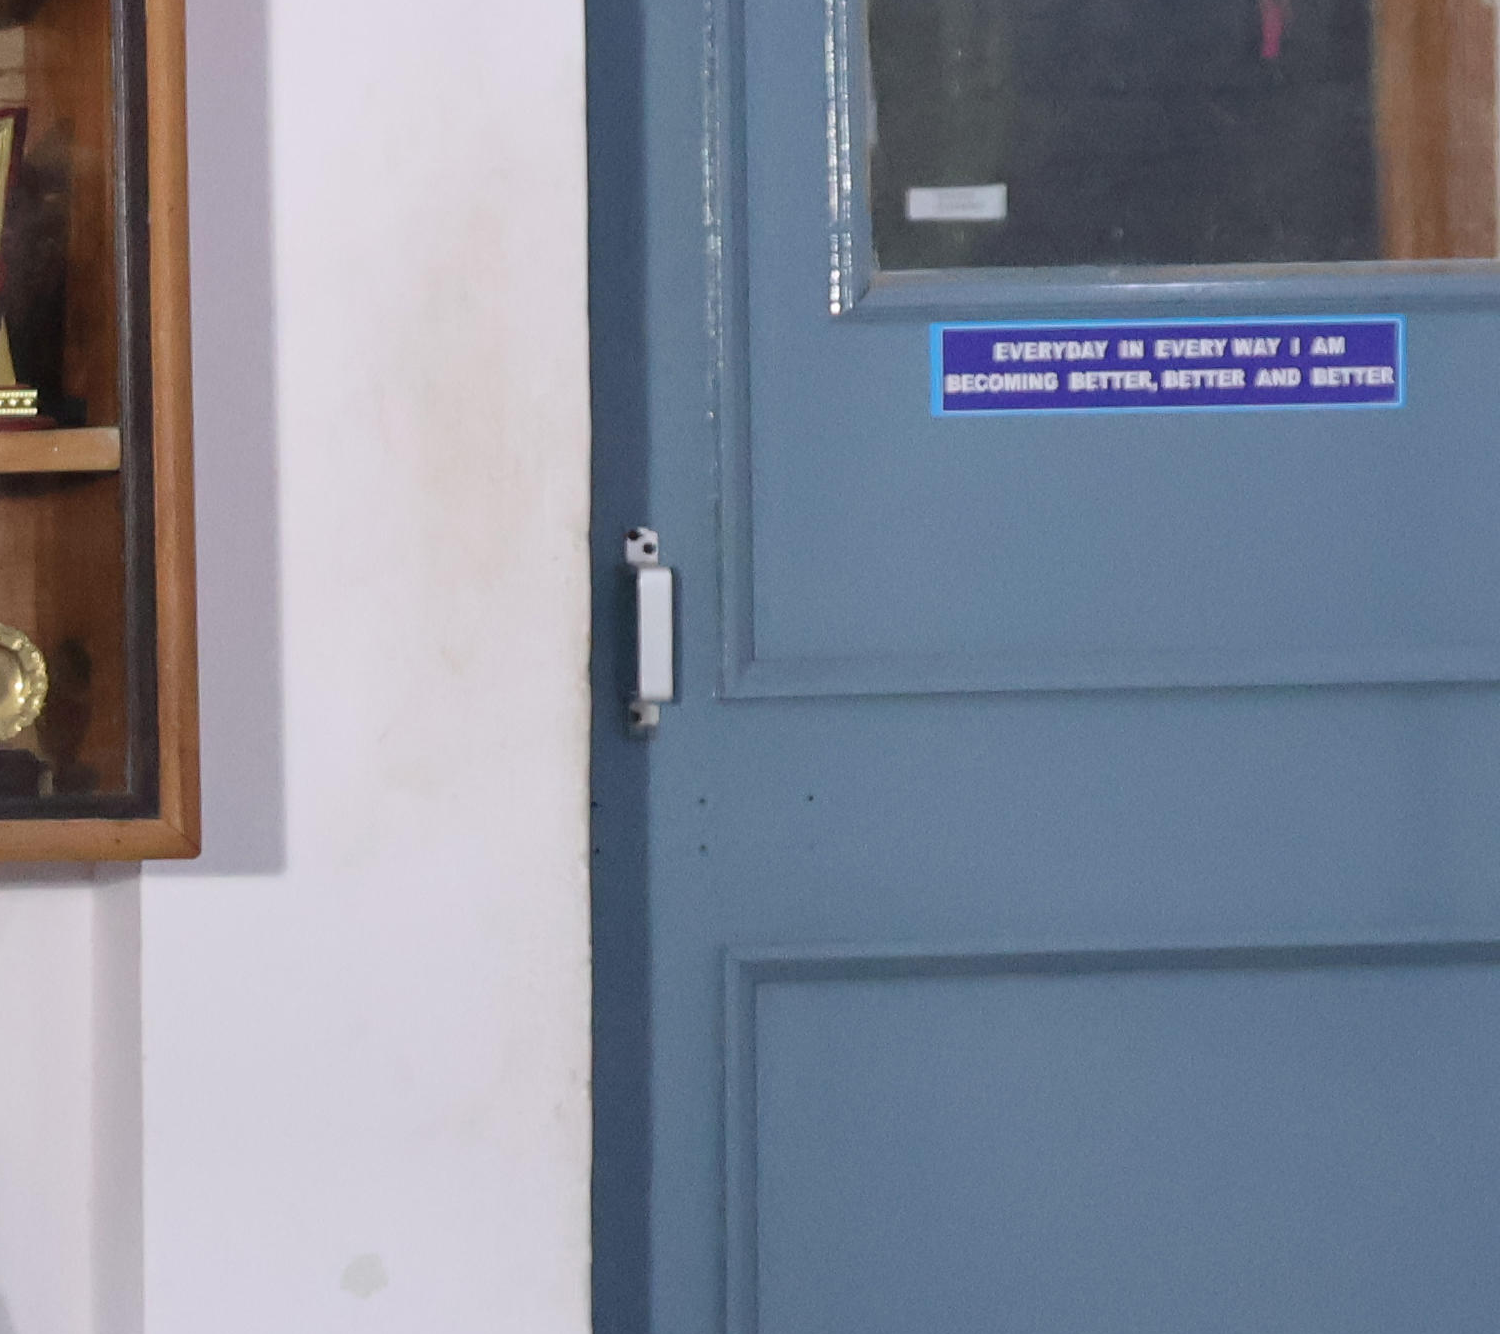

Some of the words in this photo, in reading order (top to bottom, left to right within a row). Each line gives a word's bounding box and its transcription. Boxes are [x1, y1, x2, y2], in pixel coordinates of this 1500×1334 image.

[992, 340, 1109, 363] EVERYDAY
[1118, 340, 1145, 359] IN
[1154, 338, 1228, 359] EVERY
[1230, 337, 1282, 358] WAY
[1290, 338, 1301, 356] I
[1310, 336, 1346, 355] AM
[944, 372, 1059, 394] BECOMING
[1068, 370, 1159, 393] BETTER,
[1161, 369, 1247, 389] BETTER
[1256, 367, 1302, 388] AND
[1310, 366, 1396, 387] BETTER
